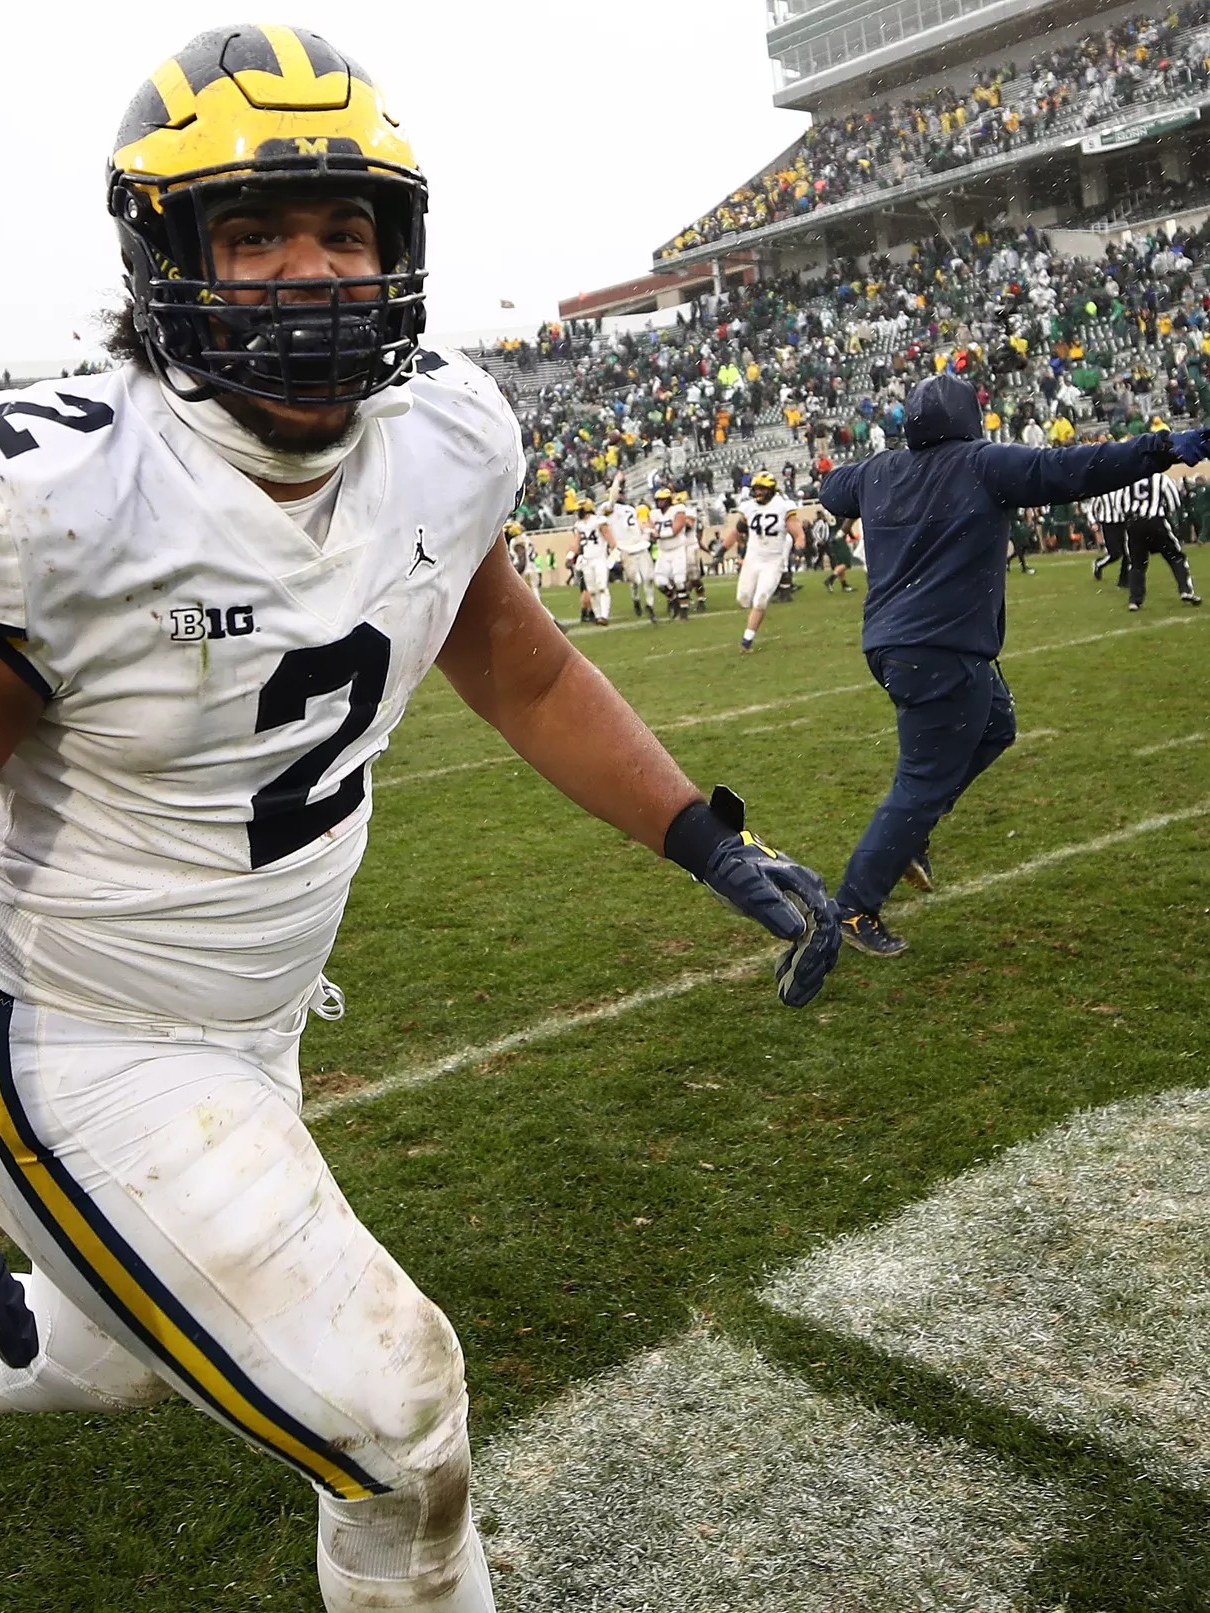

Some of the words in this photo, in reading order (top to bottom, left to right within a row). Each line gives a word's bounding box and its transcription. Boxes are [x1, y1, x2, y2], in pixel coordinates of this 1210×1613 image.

[293, 137, 328, 155] M
[1133, 478, 1149, 500] C
[750, 513, 779, 537] 42
[247, 622, 390, 869] 2
